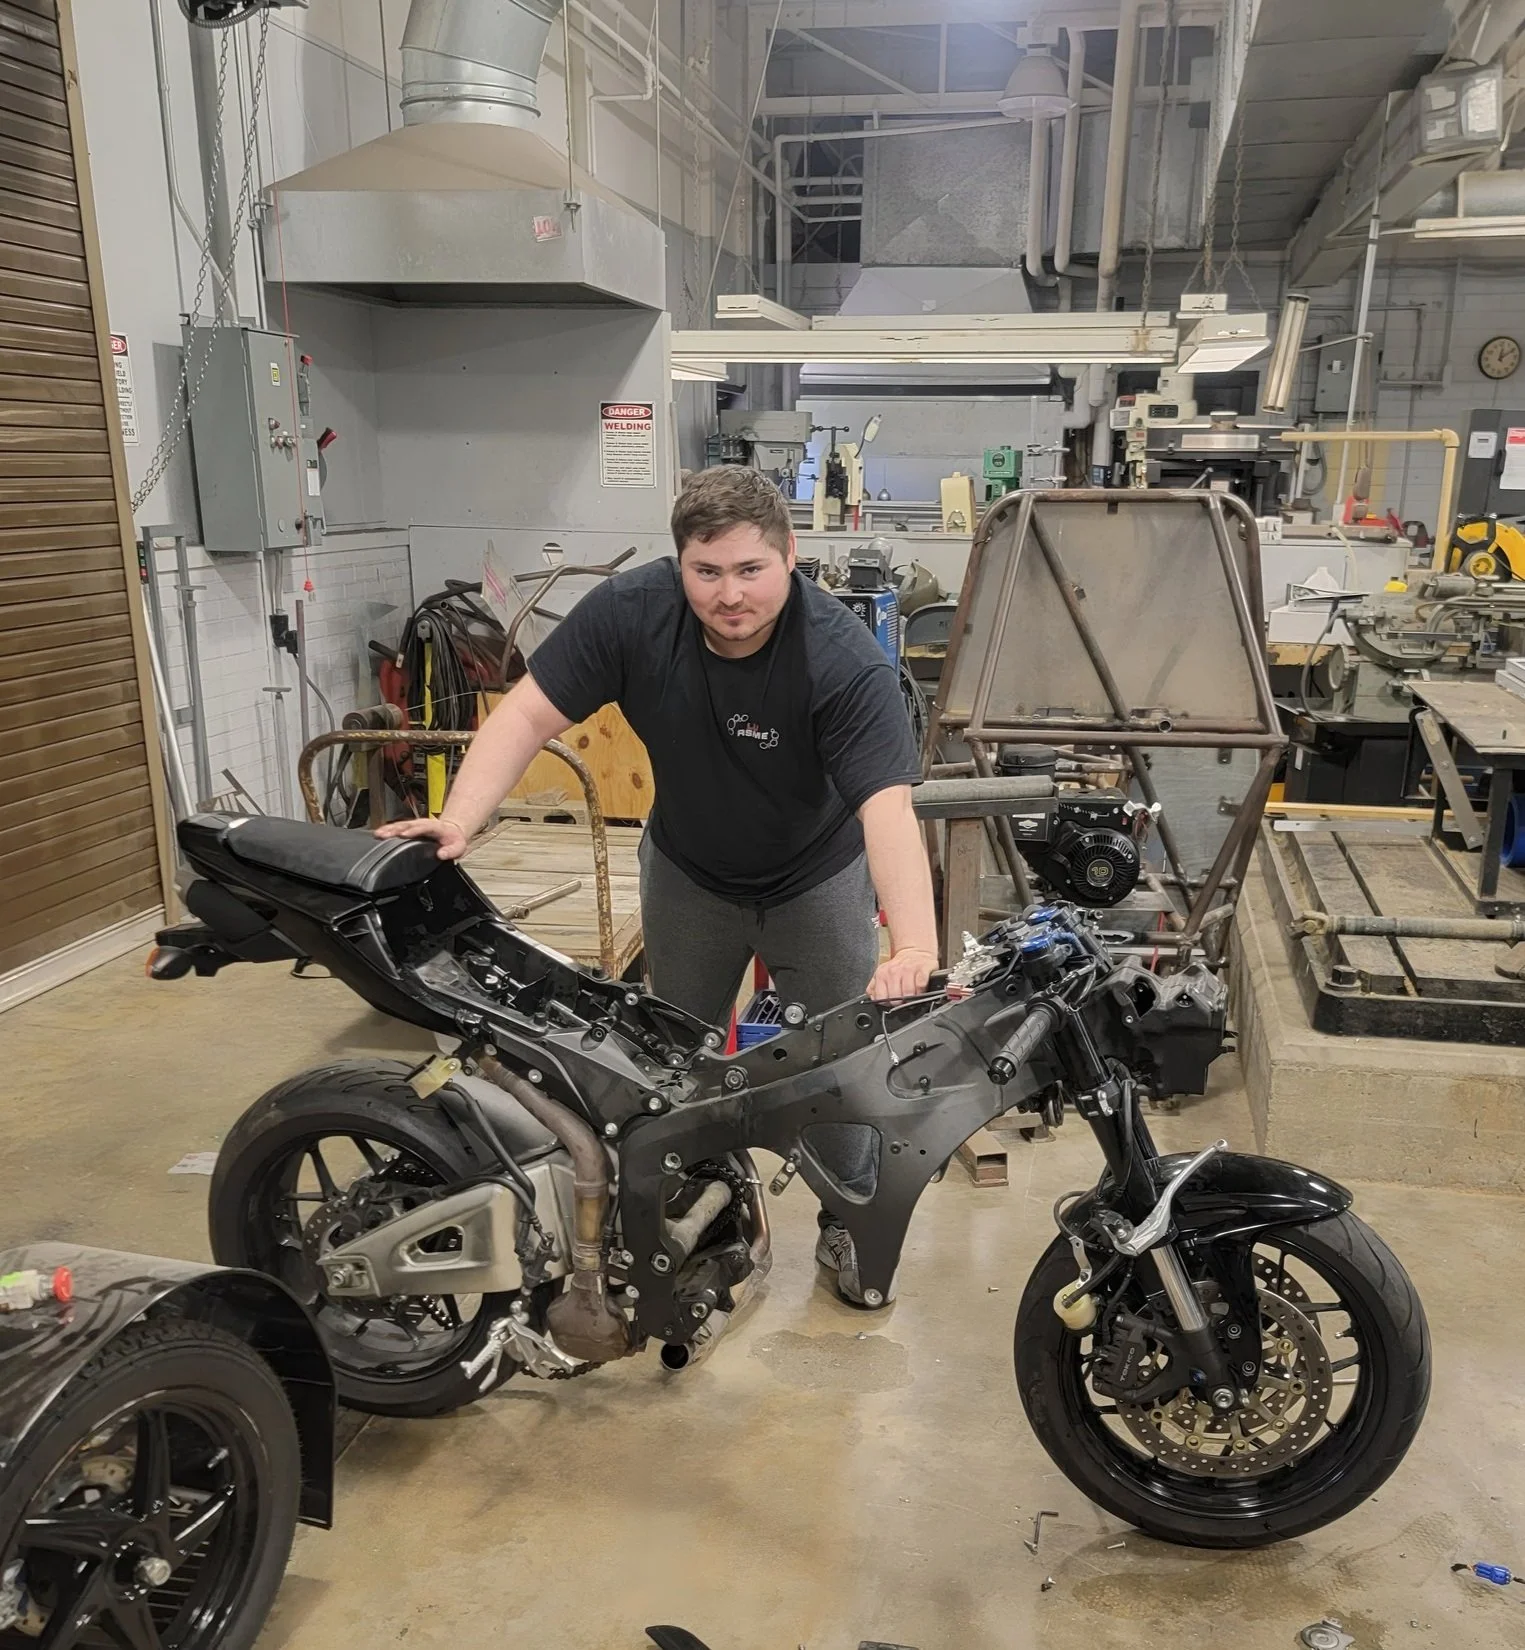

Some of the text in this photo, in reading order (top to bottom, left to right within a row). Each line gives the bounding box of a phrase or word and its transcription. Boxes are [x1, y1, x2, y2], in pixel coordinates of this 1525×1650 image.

[609, 407, 646, 416] DANGER
[737, 729, 769, 740] ASME
[1091, 866, 1109, 877] 10
